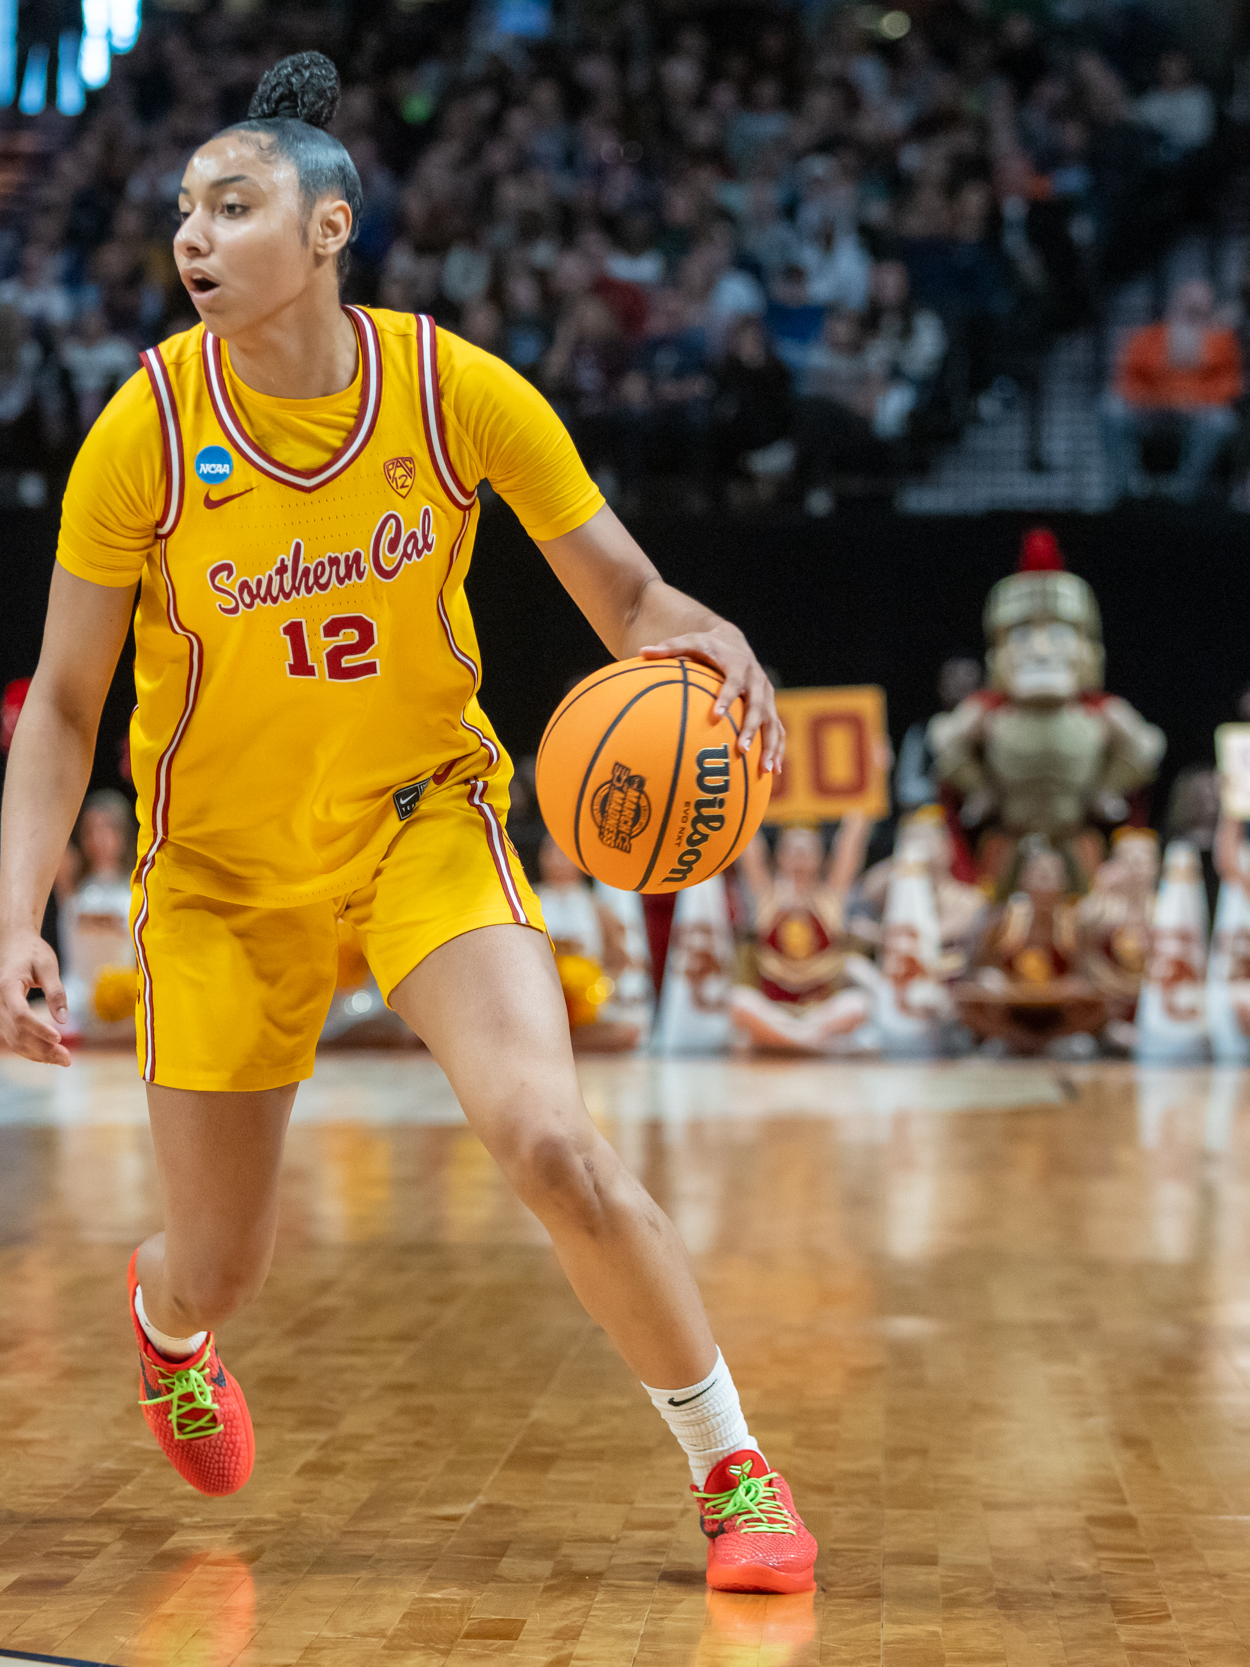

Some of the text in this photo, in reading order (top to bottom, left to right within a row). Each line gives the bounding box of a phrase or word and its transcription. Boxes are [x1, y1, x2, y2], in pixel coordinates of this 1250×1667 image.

[199, 462, 231, 475] NCAA
[386, 459, 414, 483] PAC
[394, 473, 411, 490] 12
[207, 505, 436, 616] Southern Cal
[280, 613, 381, 682] 12
[599, 789, 626, 849] MADNESS
[617, 787, 641, 834] MARCH
[661, 742, 731, 884] Wilson
[674, 801, 691, 848] EVO NXT
